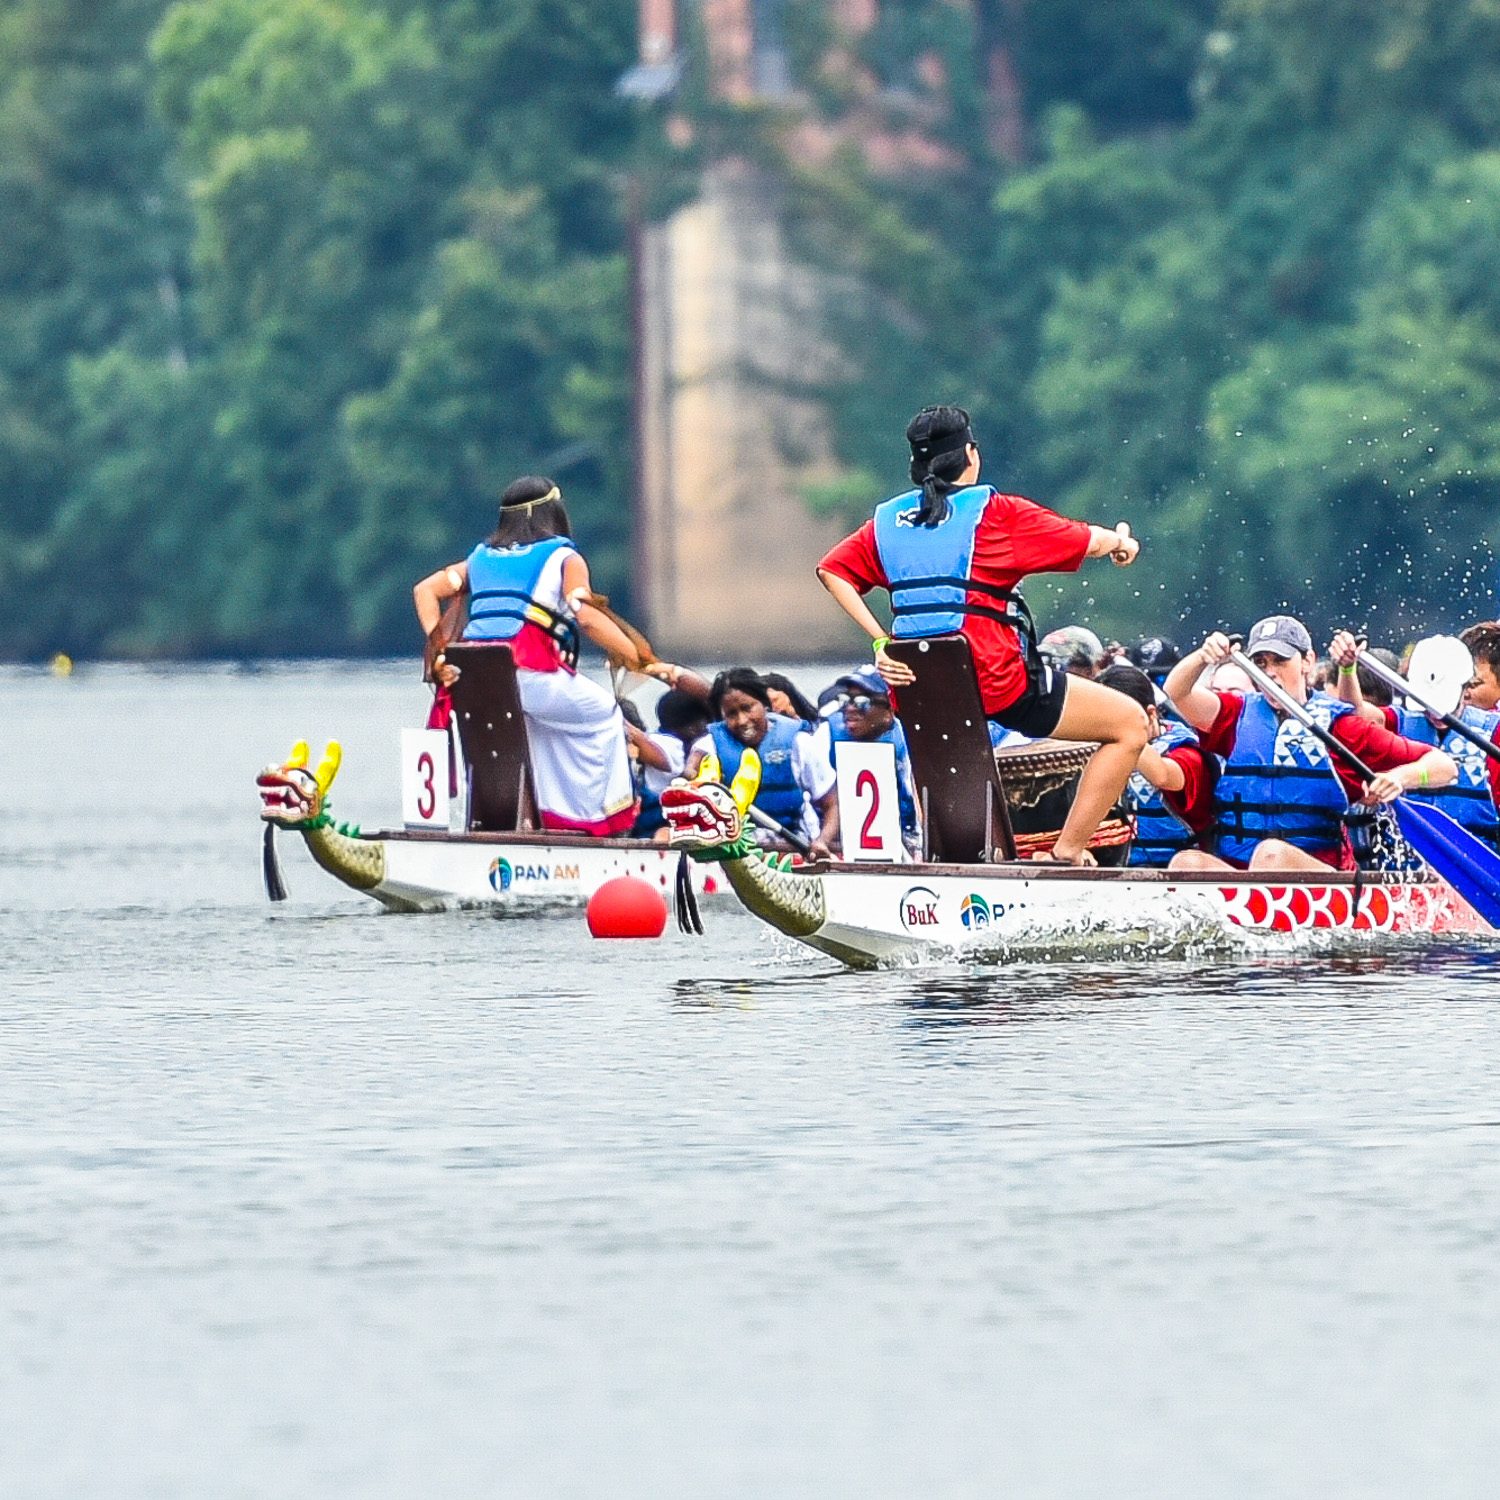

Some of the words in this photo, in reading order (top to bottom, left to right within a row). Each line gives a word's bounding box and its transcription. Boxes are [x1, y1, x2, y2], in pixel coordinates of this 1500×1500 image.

[417, 751, 436, 820] 3
[855, 769, 884, 850] 2
[514, 864, 550, 881] PAN
[553, 863, 580, 880] AM
[906, 903, 940, 926] BuK
